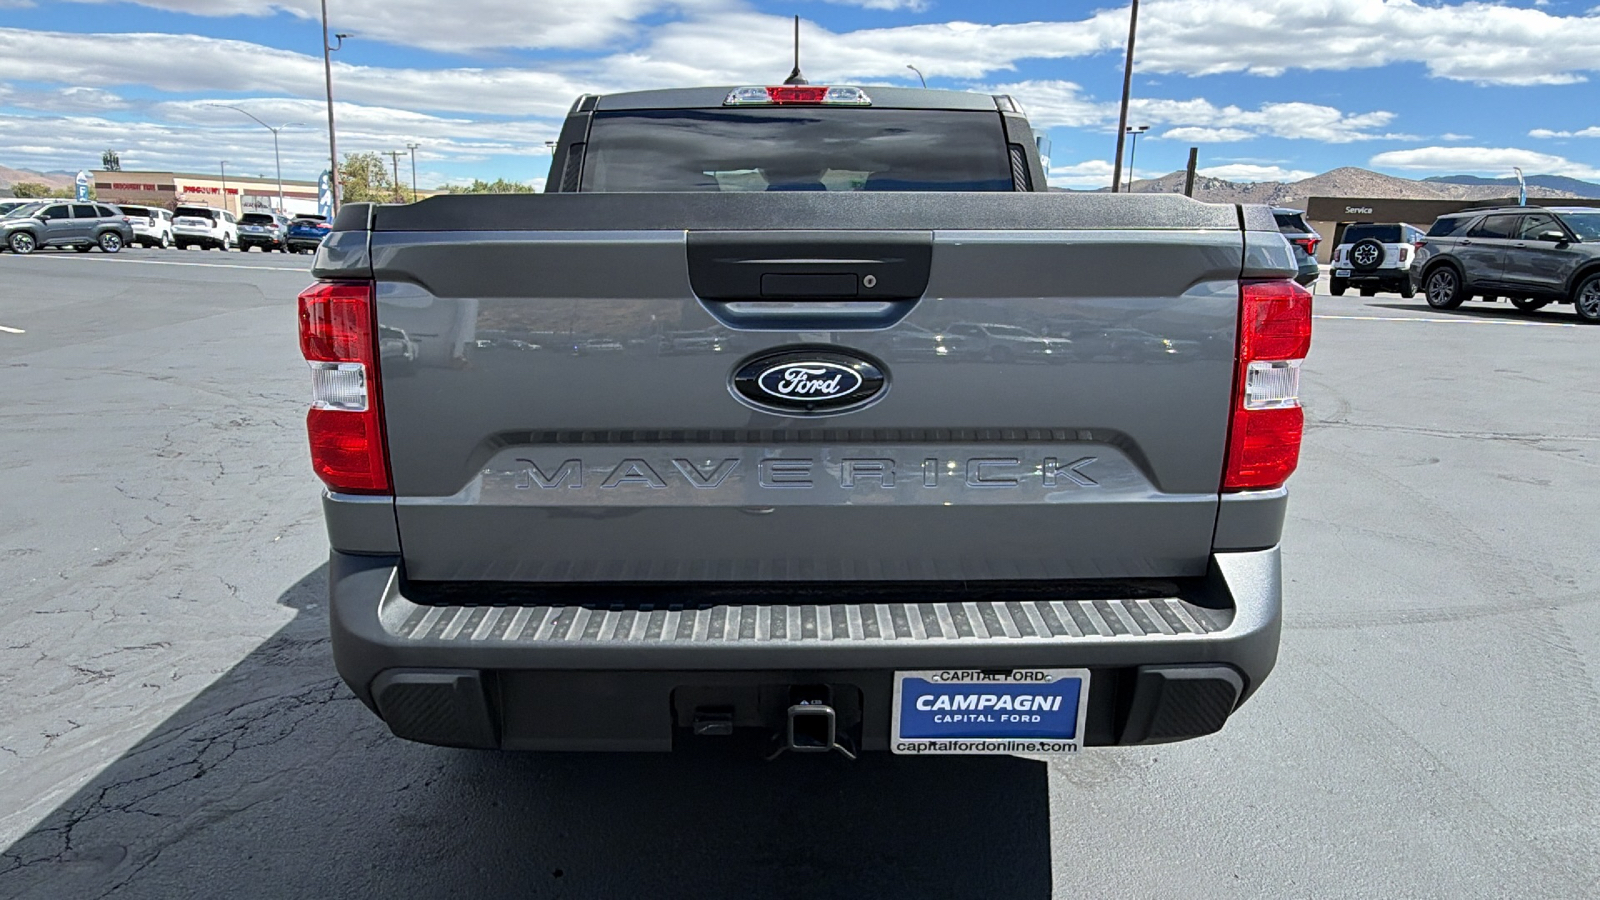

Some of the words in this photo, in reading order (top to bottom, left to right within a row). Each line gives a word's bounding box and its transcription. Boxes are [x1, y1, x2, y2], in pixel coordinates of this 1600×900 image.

[1345, 206, 1373, 214] Service
[778, 367, 842, 394] Ford
[515, 456, 1099, 489] MAVERICK
[940, 671, 1000, 681] CAPITAL
[916, 694, 1063, 711] CAMPAGNI
[934, 714, 995, 723] CAPITAL
[1001, 714, 1041, 723] FORD
[896, 740, 1078, 753] capitalfordonline.com
